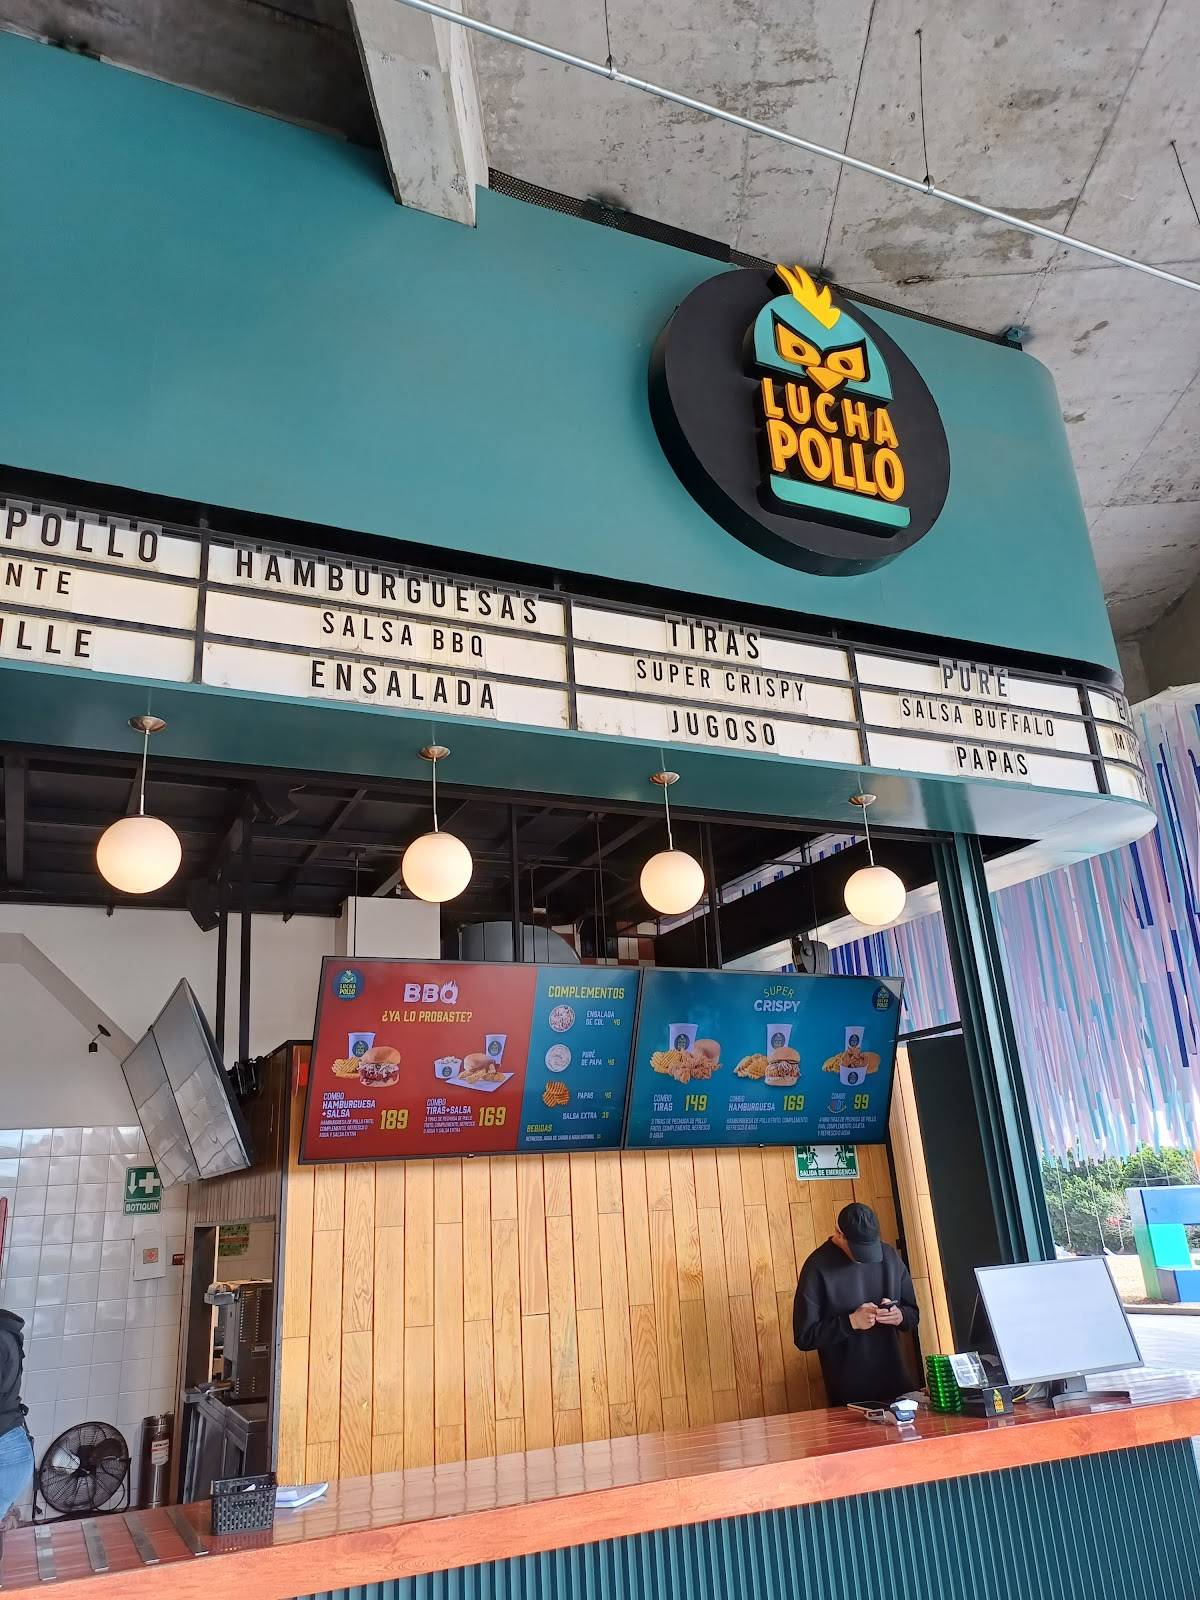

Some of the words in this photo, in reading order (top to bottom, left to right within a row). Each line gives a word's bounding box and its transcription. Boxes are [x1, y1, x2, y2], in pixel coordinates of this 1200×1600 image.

[761, 377, 898, 449] LUCHA
[766, 419, 905, 502] POLLO
[5, 506, 159, 563] POLLO
[5, 562, 72, 595] NTE
[236, 549, 538, 624] HAMBURGUESAS
[322, 611, 413, 646] SALSA
[433, 629, 484, 659] BBQ
[667, 619, 760, 660] TIRAS
[311, 660, 495, 710] ENSALADA
[636, 659, 711, 689] SUPER
[725, 672, 804, 702] CRISPY
[942, 664, 1008, 698] PURÉ
[671, 710, 776, 746] JUGOSO
[902, 698, 963, 725] SALSA
[974, 708, 1055, 737] BUFFALO
[957, 746, 1029, 776] PAPAS
[404, 980, 459, 1004] BBQ
[548, 985, 626, 999] COMPLEMENTOS
[763, 985, 794, 999] SUPER
[753, 999, 801, 1013] CRISPY
[382, 1011, 400, 1022] ¿YA
[403, 1011, 417, 1022] LO
[418, 1011, 473, 1023] PROBASTE?
[322, 1100, 376, 1109] HAMBURGUESA
[323, 1092, 345, 1100] COMBO
[426, 1098, 447, 1107] COMBO
[685, 1094, 708, 1112] 149
[783, 1095, 805, 1111] 169
[853, 1093, 870, 1110] 99
[478, 1106, 507, 1127] 169
[580, 1111, 597, 1119] EXTRA
[653, 1102, 673, 1112] TIRAS
[728, 1102, 776, 1112] HAMBURGUESA
[380, 1109, 409, 1130] 189
[799, 1169, 817, 1177] SALIDA
[825, 1168, 857, 1176] EMERGENCIA
